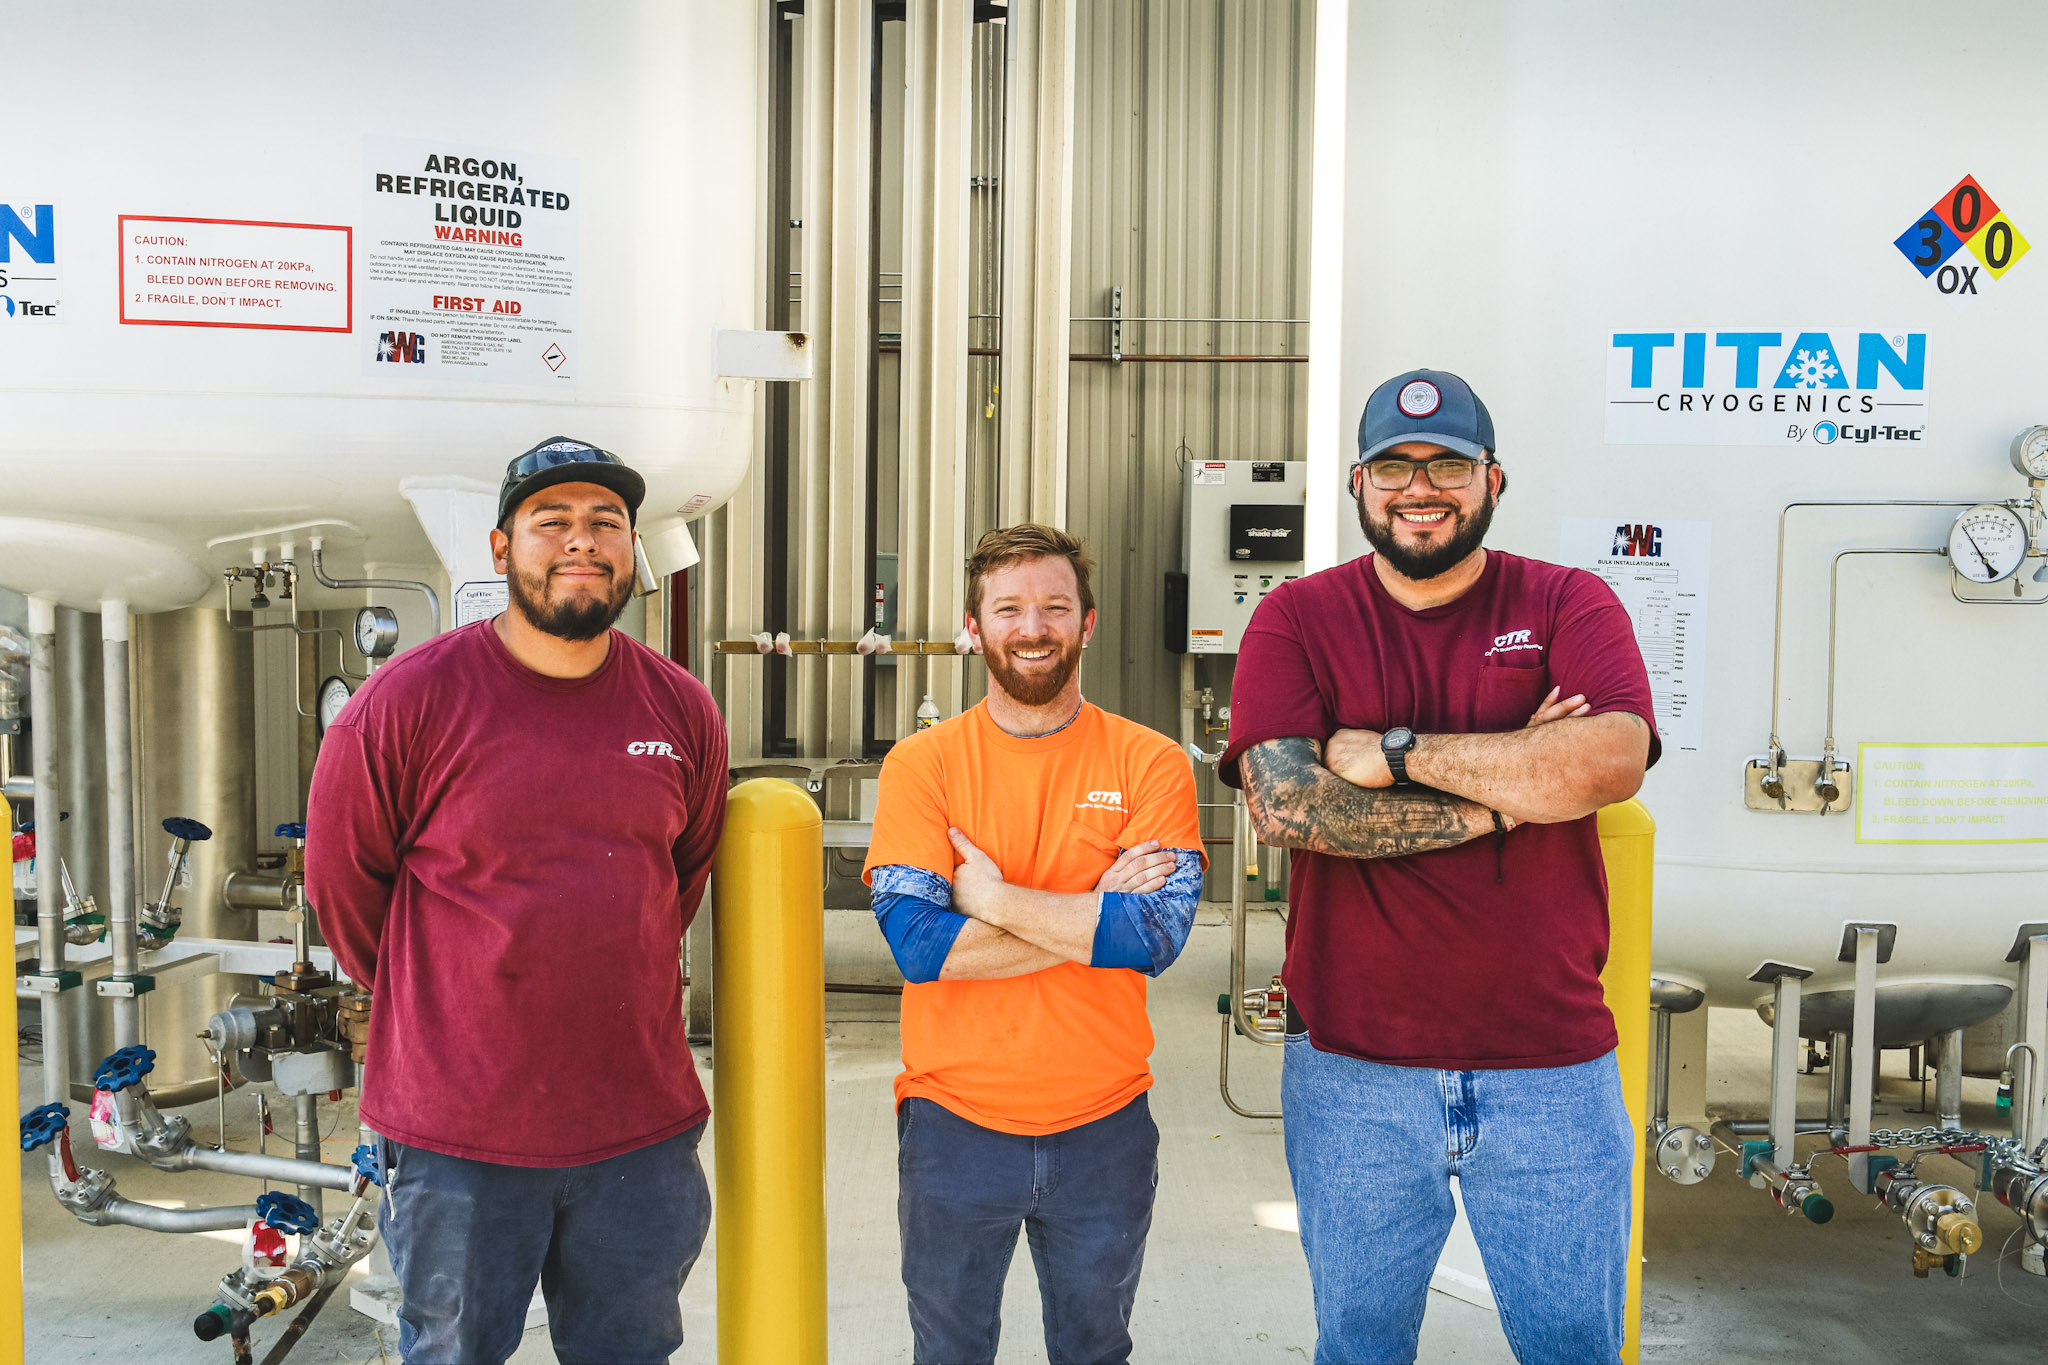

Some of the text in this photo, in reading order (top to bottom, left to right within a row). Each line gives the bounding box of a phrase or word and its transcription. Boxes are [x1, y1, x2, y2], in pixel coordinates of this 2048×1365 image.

[425, 154, 523, 185] ARGON,
[376, 173, 570, 211] REFRIGERATED
[435, 203, 522, 229] LIQUID
[1952, 185, 1981, 233] 0
[134, 235, 188, 246] CAUTION:
[434, 225, 523, 246] WARNING
[1914, 219, 1942, 266] 3
[1985, 222, 2012, 269] 0
[135, 255, 314, 273] 1. CONTAIN NITROGEN AT 20KPa,
[147, 275, 337, 292] BLEED DOWN BEFORE REMOVING.
[1936, 265, 1979, 295] OX
[19, 301, 56, 316] Tec
[135, 294, 283, 308] 2. FRAGILE, DON'T IMPACT.
[433, 295, 522, 314] FIRST AID
[376, 331, 425, 364] AWG
[1612, 332, 1927, 390] TITAN
[1657, 394, 1874, 414] CRYOGENICS
[1787, 425, 1921, 443] By Cyl-Tec
[1271, 529, 1288, 538] aide
[1612, 524, 1662, 557] AWG
[1494, 629, 1531, 647] CTR
[627, 741, 673, 756] CTR
[1885, 779, 1930, 788] CONTAIN
[1934, 779, 1986, 788] NITROGEN
[1989, 779, 2001, 787] AT
[1087, 791, 1122, 804] CTR
[1884, 797, 1919, 806] BLEED
[1922, 797, 1956, 806] DOWN
[1957, 797, 1998, 806] BEFORE
[1935, 816, 1966, 824] DON'T
